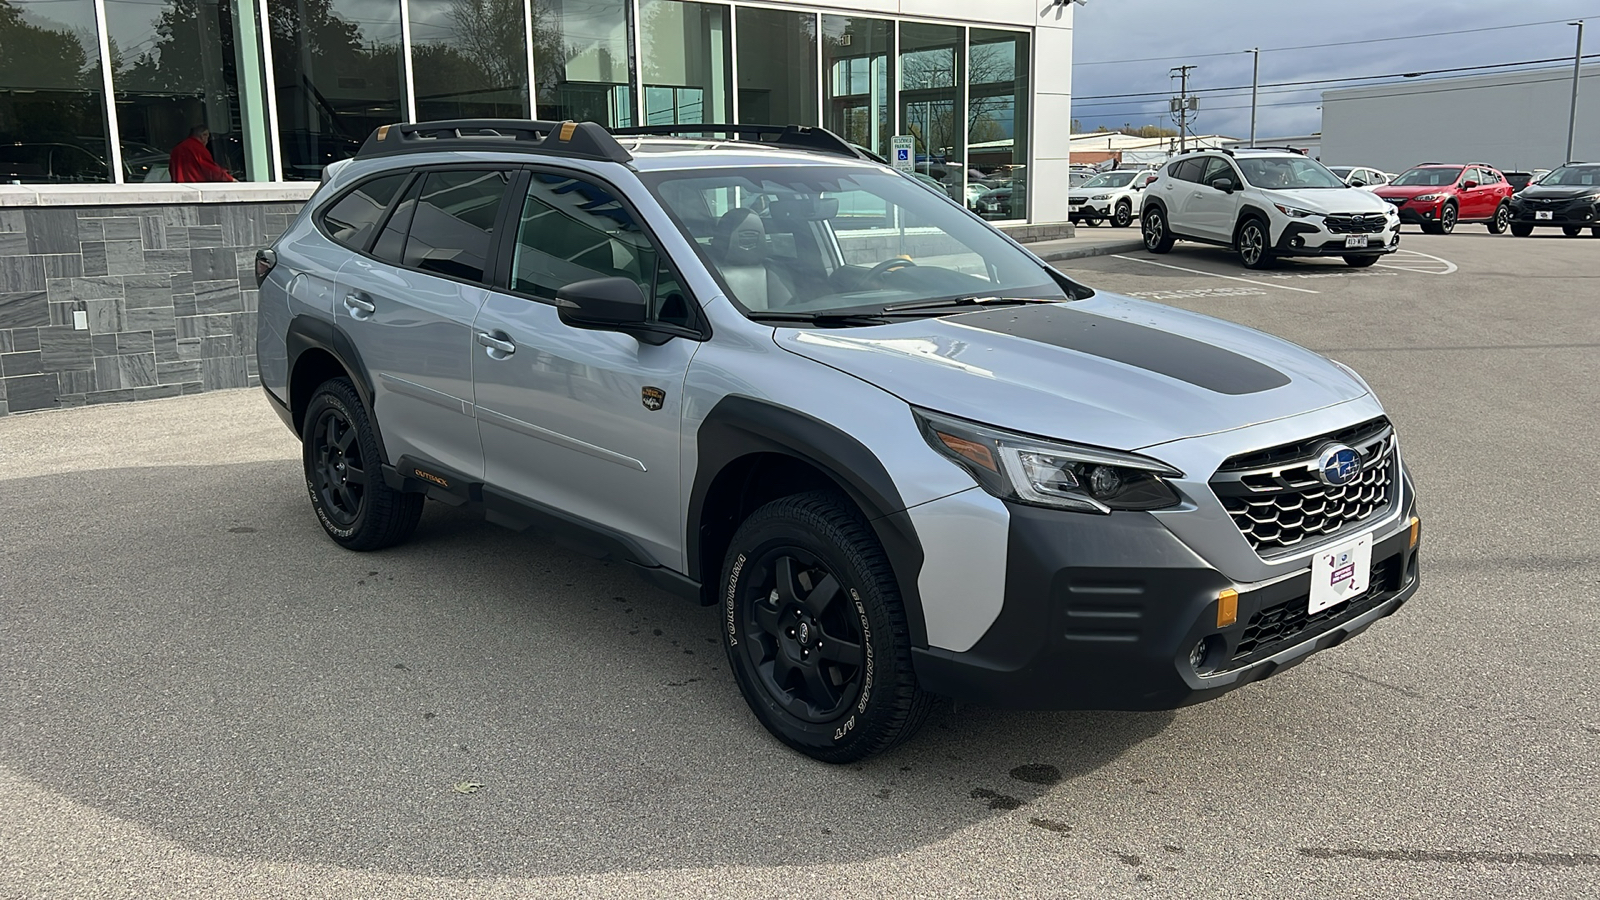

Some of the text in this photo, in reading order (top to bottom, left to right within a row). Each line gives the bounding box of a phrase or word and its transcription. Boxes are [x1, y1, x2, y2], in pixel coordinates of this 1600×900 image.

[415, 469, 448, 487] OUTBACK
[726, 554, 746, 647] YOKOHAMA
[834, 588, 874, 740] GEOLANDAR A/T
